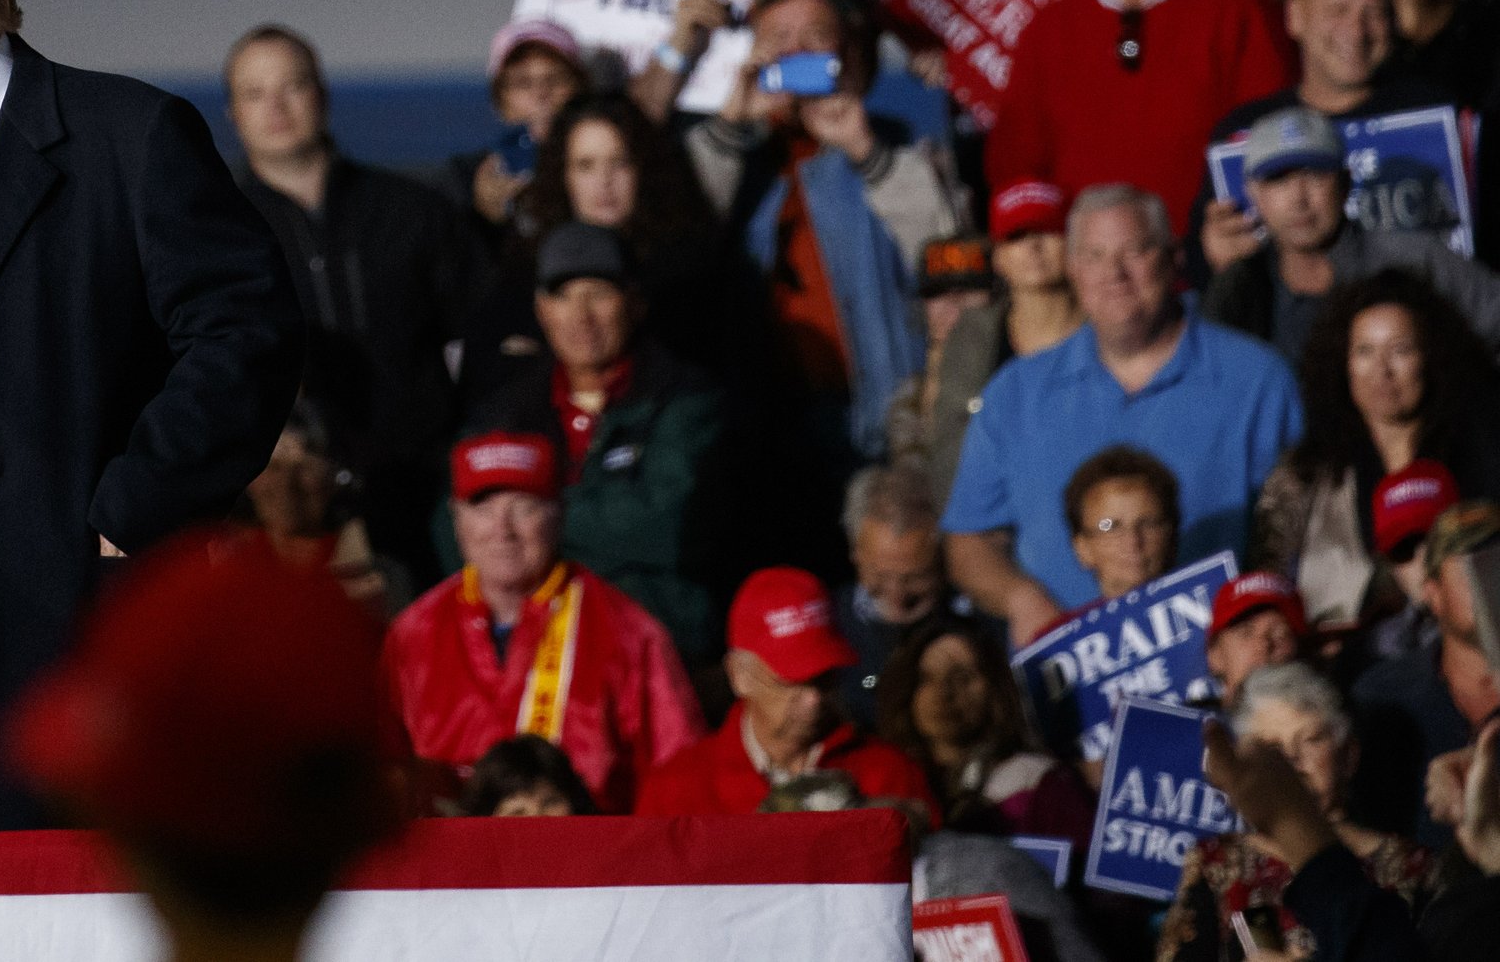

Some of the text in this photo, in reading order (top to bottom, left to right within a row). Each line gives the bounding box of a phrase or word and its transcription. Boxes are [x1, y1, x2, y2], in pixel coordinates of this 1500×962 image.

[1040, 582, 1214, 703] DRAIN
[1109, 765, 1244, 835] AME
[1102, 816, 1198, 868] STRO
